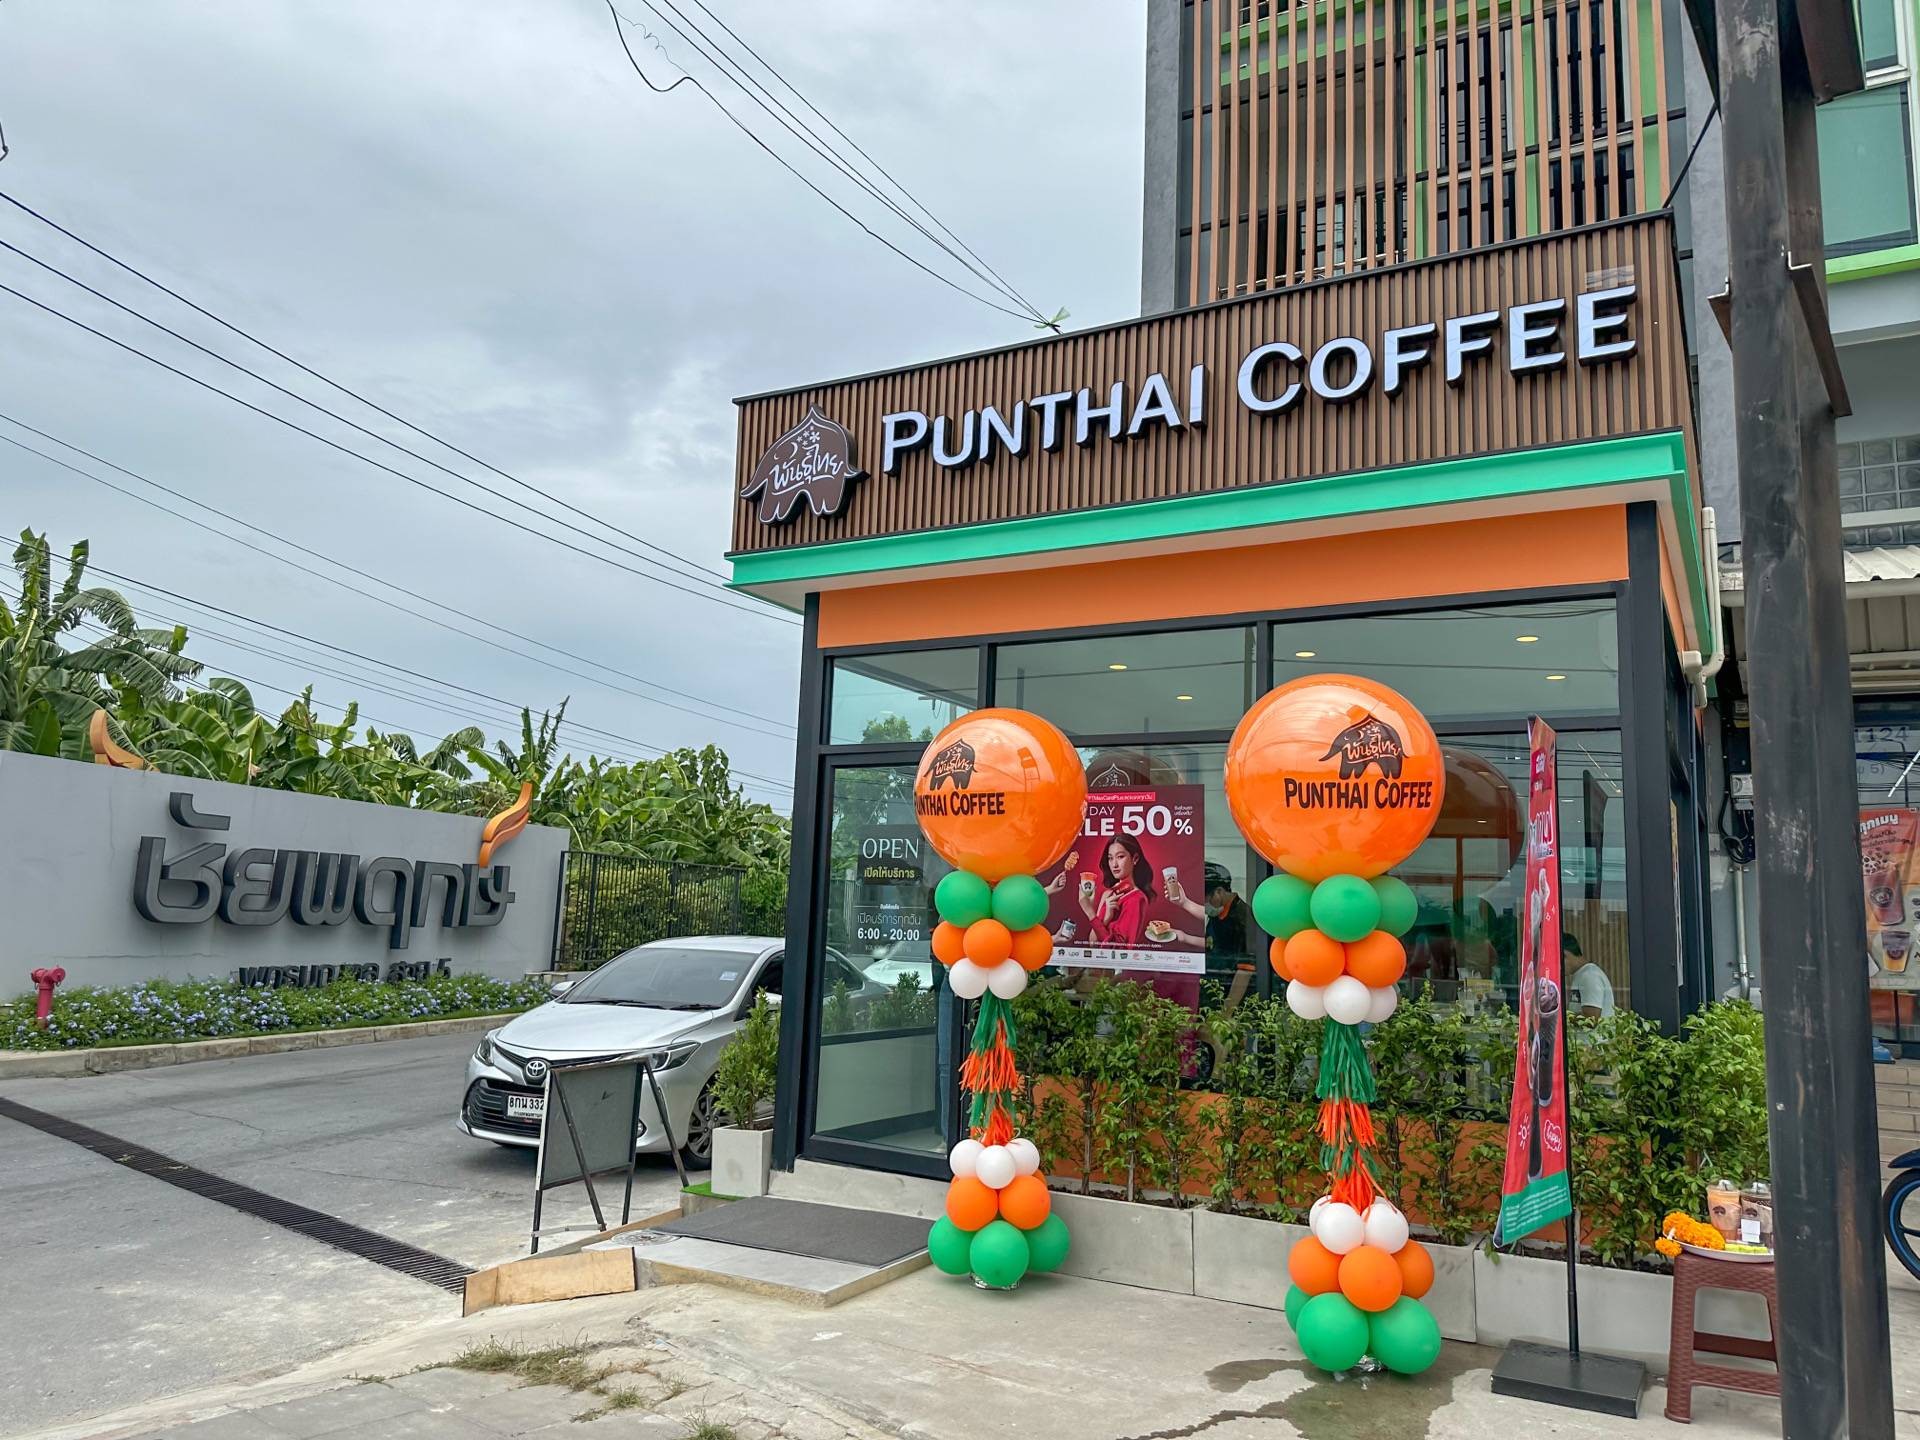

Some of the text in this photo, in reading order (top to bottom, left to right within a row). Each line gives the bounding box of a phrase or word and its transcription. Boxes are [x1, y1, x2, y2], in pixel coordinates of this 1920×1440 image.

[882, 285, 1638, 477] PUNTHAI COFFEE
[769, 443, 844, 490] พันธุ์ไทย
[1342, 733, 1401, 760] พันธุ์ไทย
[914, 791, 1006, 816] UNTHAI COFFEE
[1284, 778, 1433, 809] PUNTHAI COFFEE
[1079, 818, 1115, 836] LE
[862, 838, 919, 859] OPEN
[864, 866, 915, 879] เปิดให้บริการ
[857, 912, 921, 927] เปิดบริการทุกวัน
[857, 927, 880, 940] 6:00
[889, 928, 920, 941] 20:00
